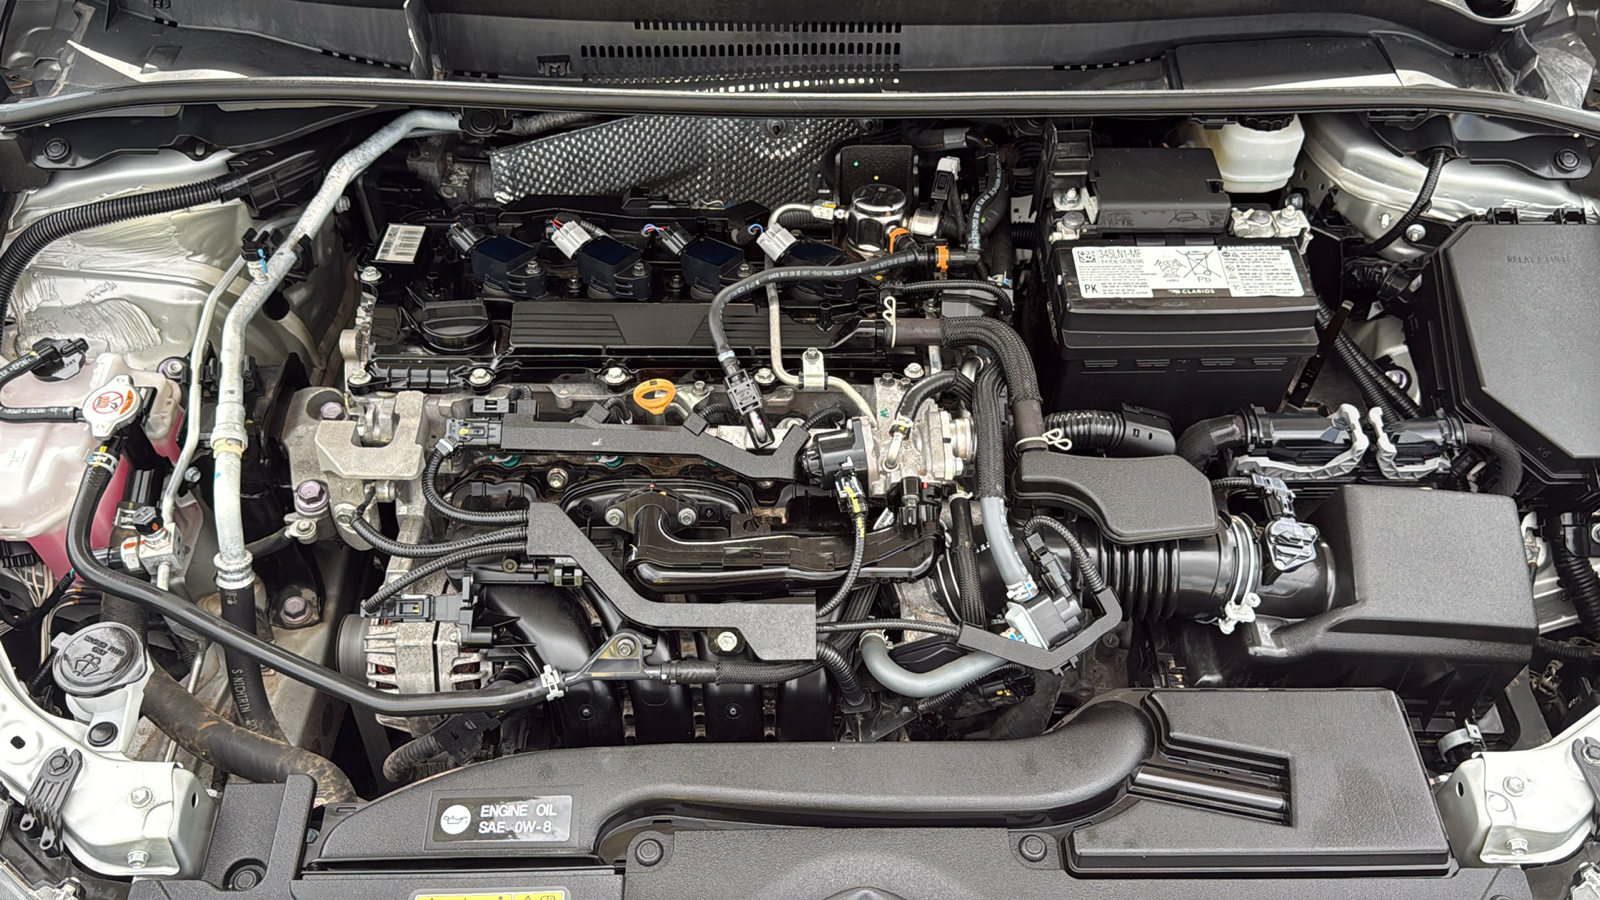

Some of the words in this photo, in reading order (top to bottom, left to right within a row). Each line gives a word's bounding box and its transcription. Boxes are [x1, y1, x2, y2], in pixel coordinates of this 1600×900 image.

[1084, 284, 1098, 294] PK
[480, 804, 528, 818] ENGINE
[536, 803, 558, 817] OIL
[478, 821, 505, 834] SAE
[514, 820, 552, 833] 0W-8
